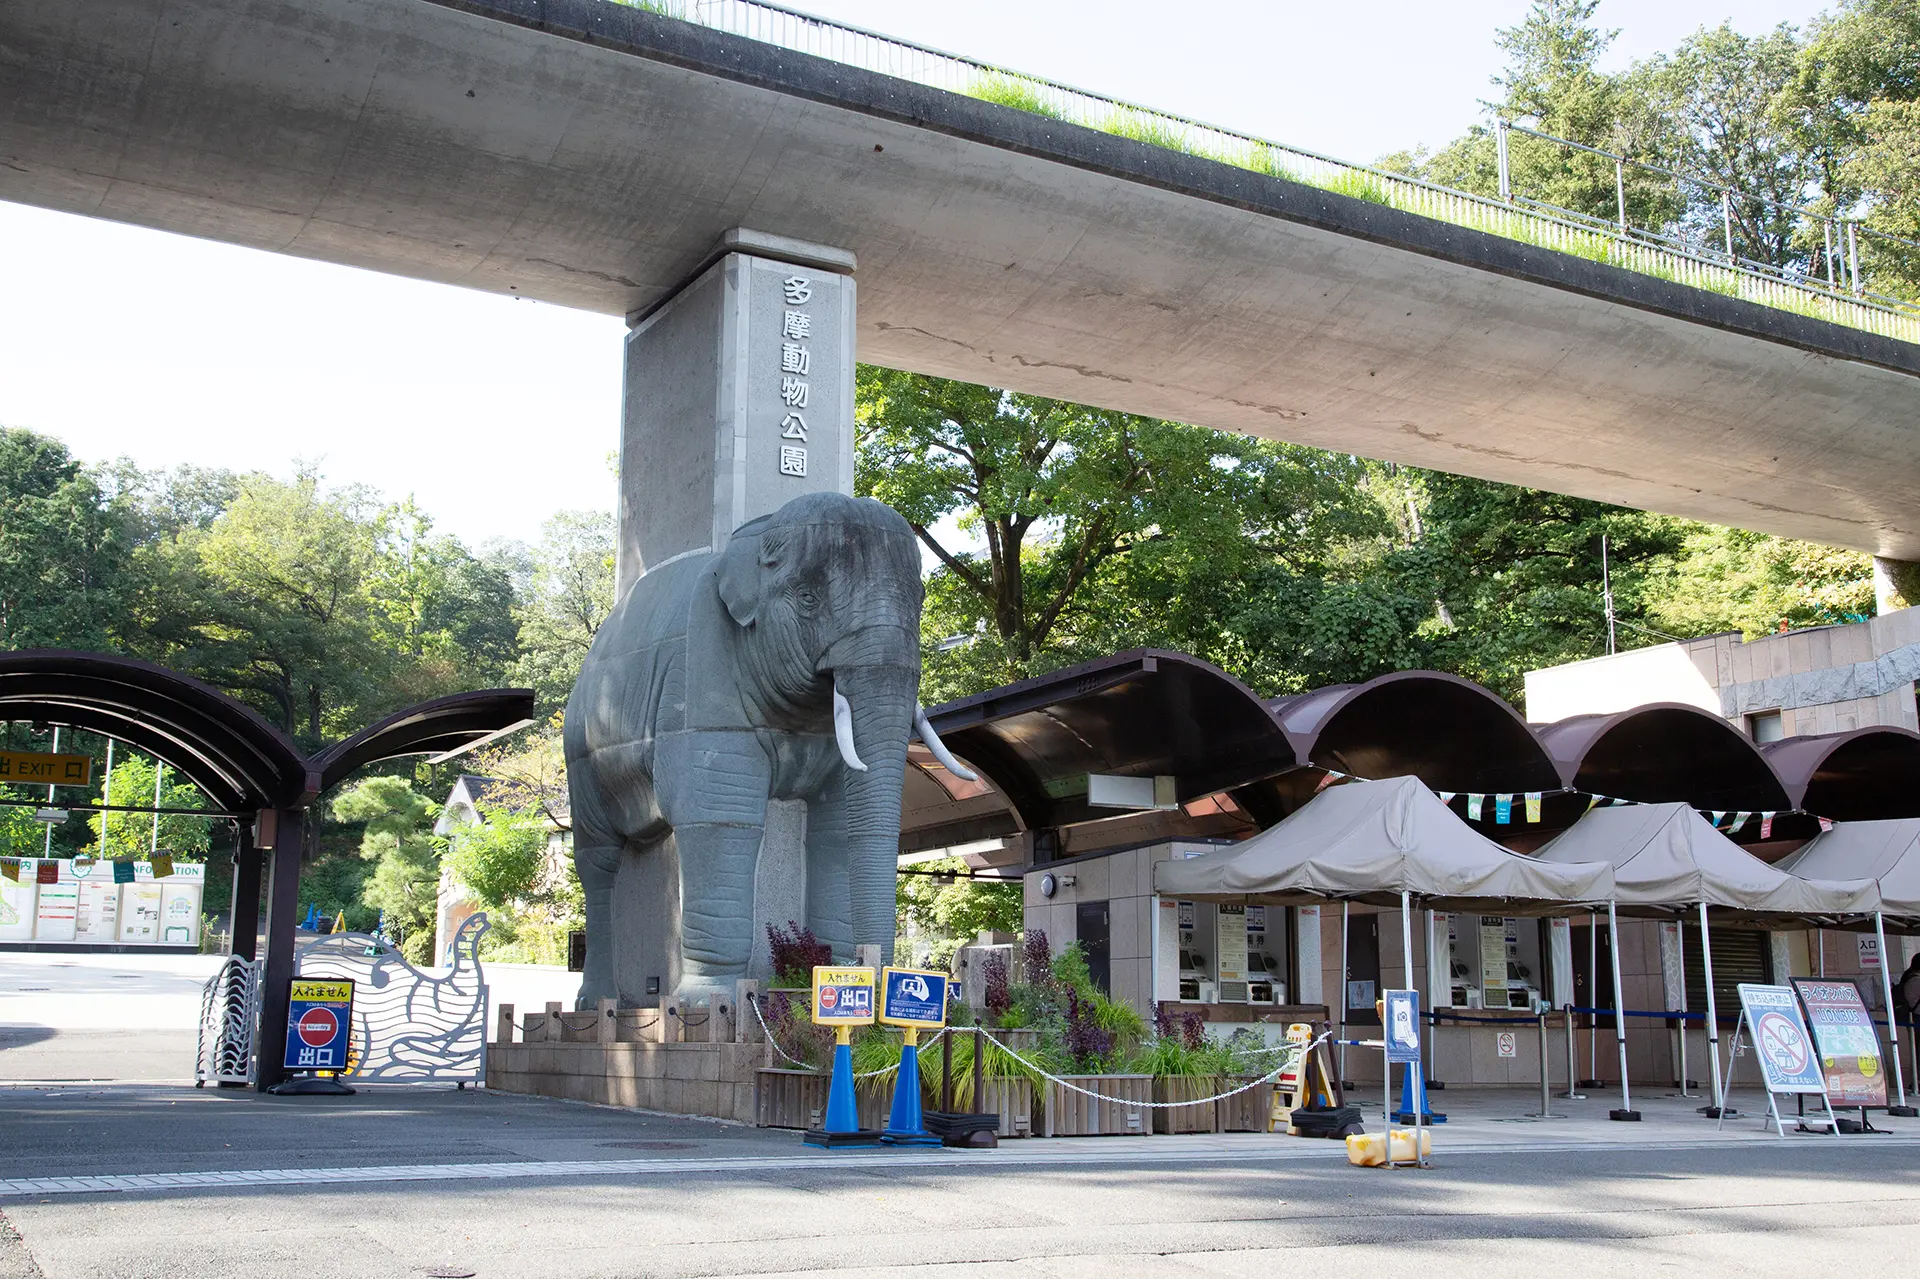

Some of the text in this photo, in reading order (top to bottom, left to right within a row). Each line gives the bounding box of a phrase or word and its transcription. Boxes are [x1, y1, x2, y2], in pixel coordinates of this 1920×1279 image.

[779, 275, 813, 478] 多摩動物公園
[19, 761, 56, 776] EXIT
[65, 761, 83, 779] 口
[1860, 940, 1877, 949] 入口
[827, 973, 866, 983] 入れません
[293, 986, 348, 998] 入れません
[840, 988, 869, 1008] 出口
[1747, 992, 1791, 1004] 持ち込み禁止
[1801, 986, 1858, 1001] ライオンバス
[1818, 1008, 1860, 1022] LION BUS
[298, 1047, 333, 1065] 出口
